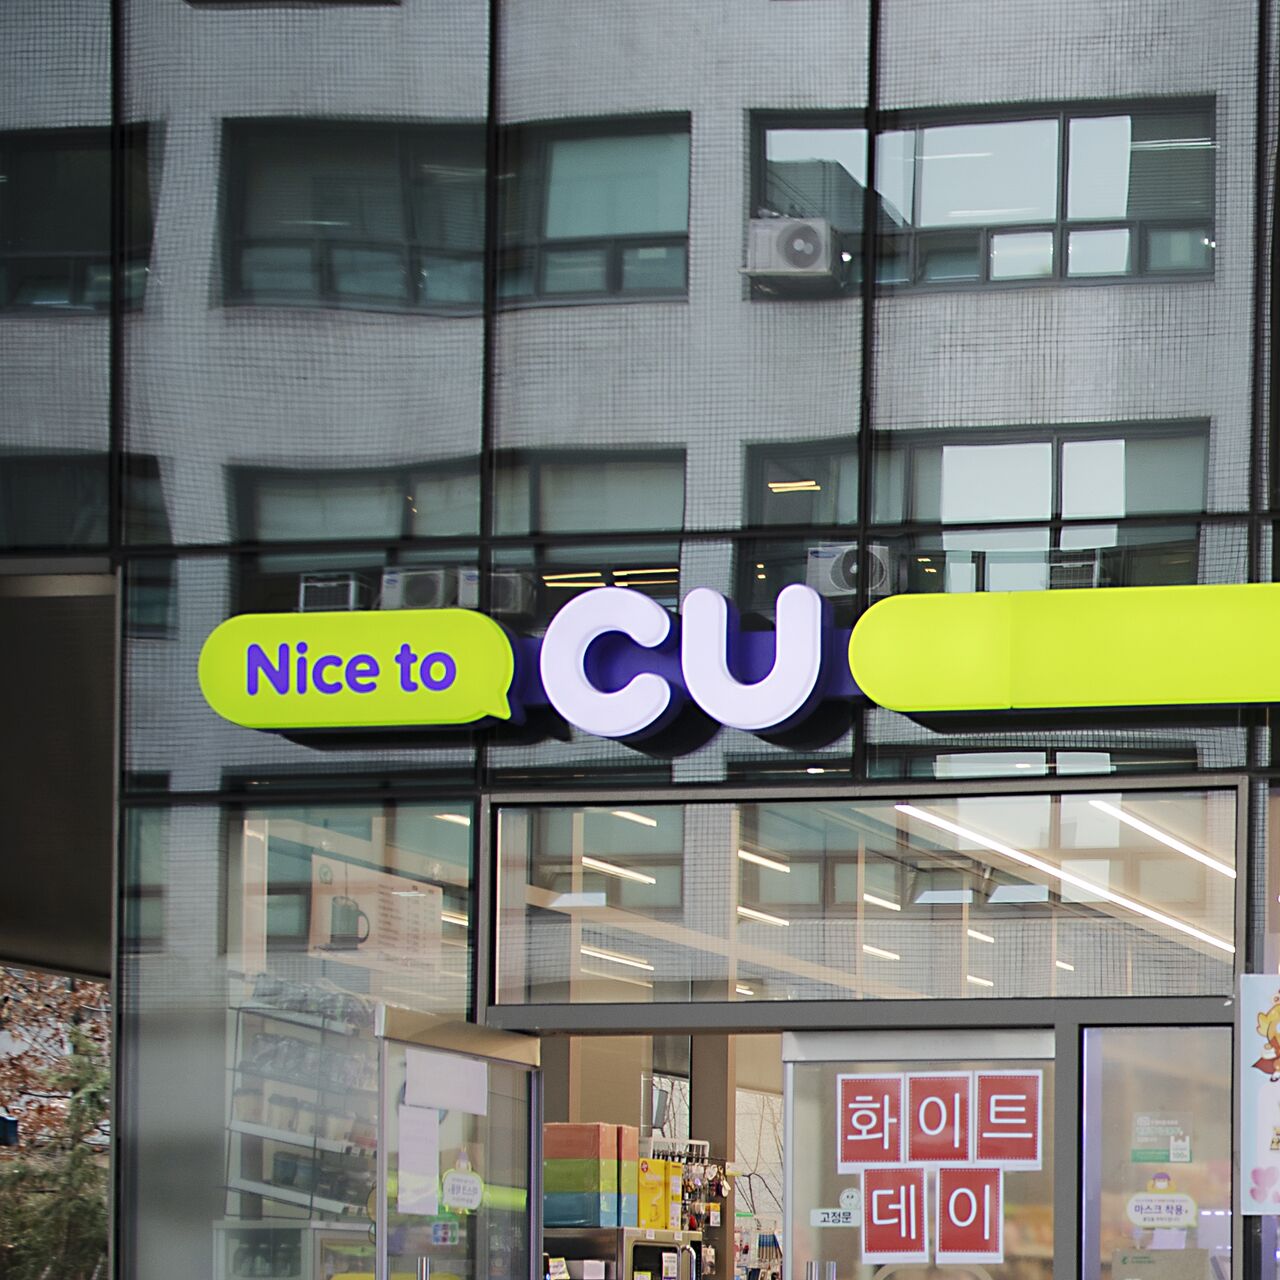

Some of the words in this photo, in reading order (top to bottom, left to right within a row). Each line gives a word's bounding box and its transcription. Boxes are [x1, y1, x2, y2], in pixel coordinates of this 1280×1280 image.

[246, 641, 380, 696] Nice
[395, 643, 457, 692] to
[540, 583, 823, 738] CU
[847, 1092, 1033, 1150] 화이트
[820, 1211, 852, 1224] 고정문
[872, 1184, 990, 1240] 데이
[1134, 1204, 1162, 1215] 마스크
